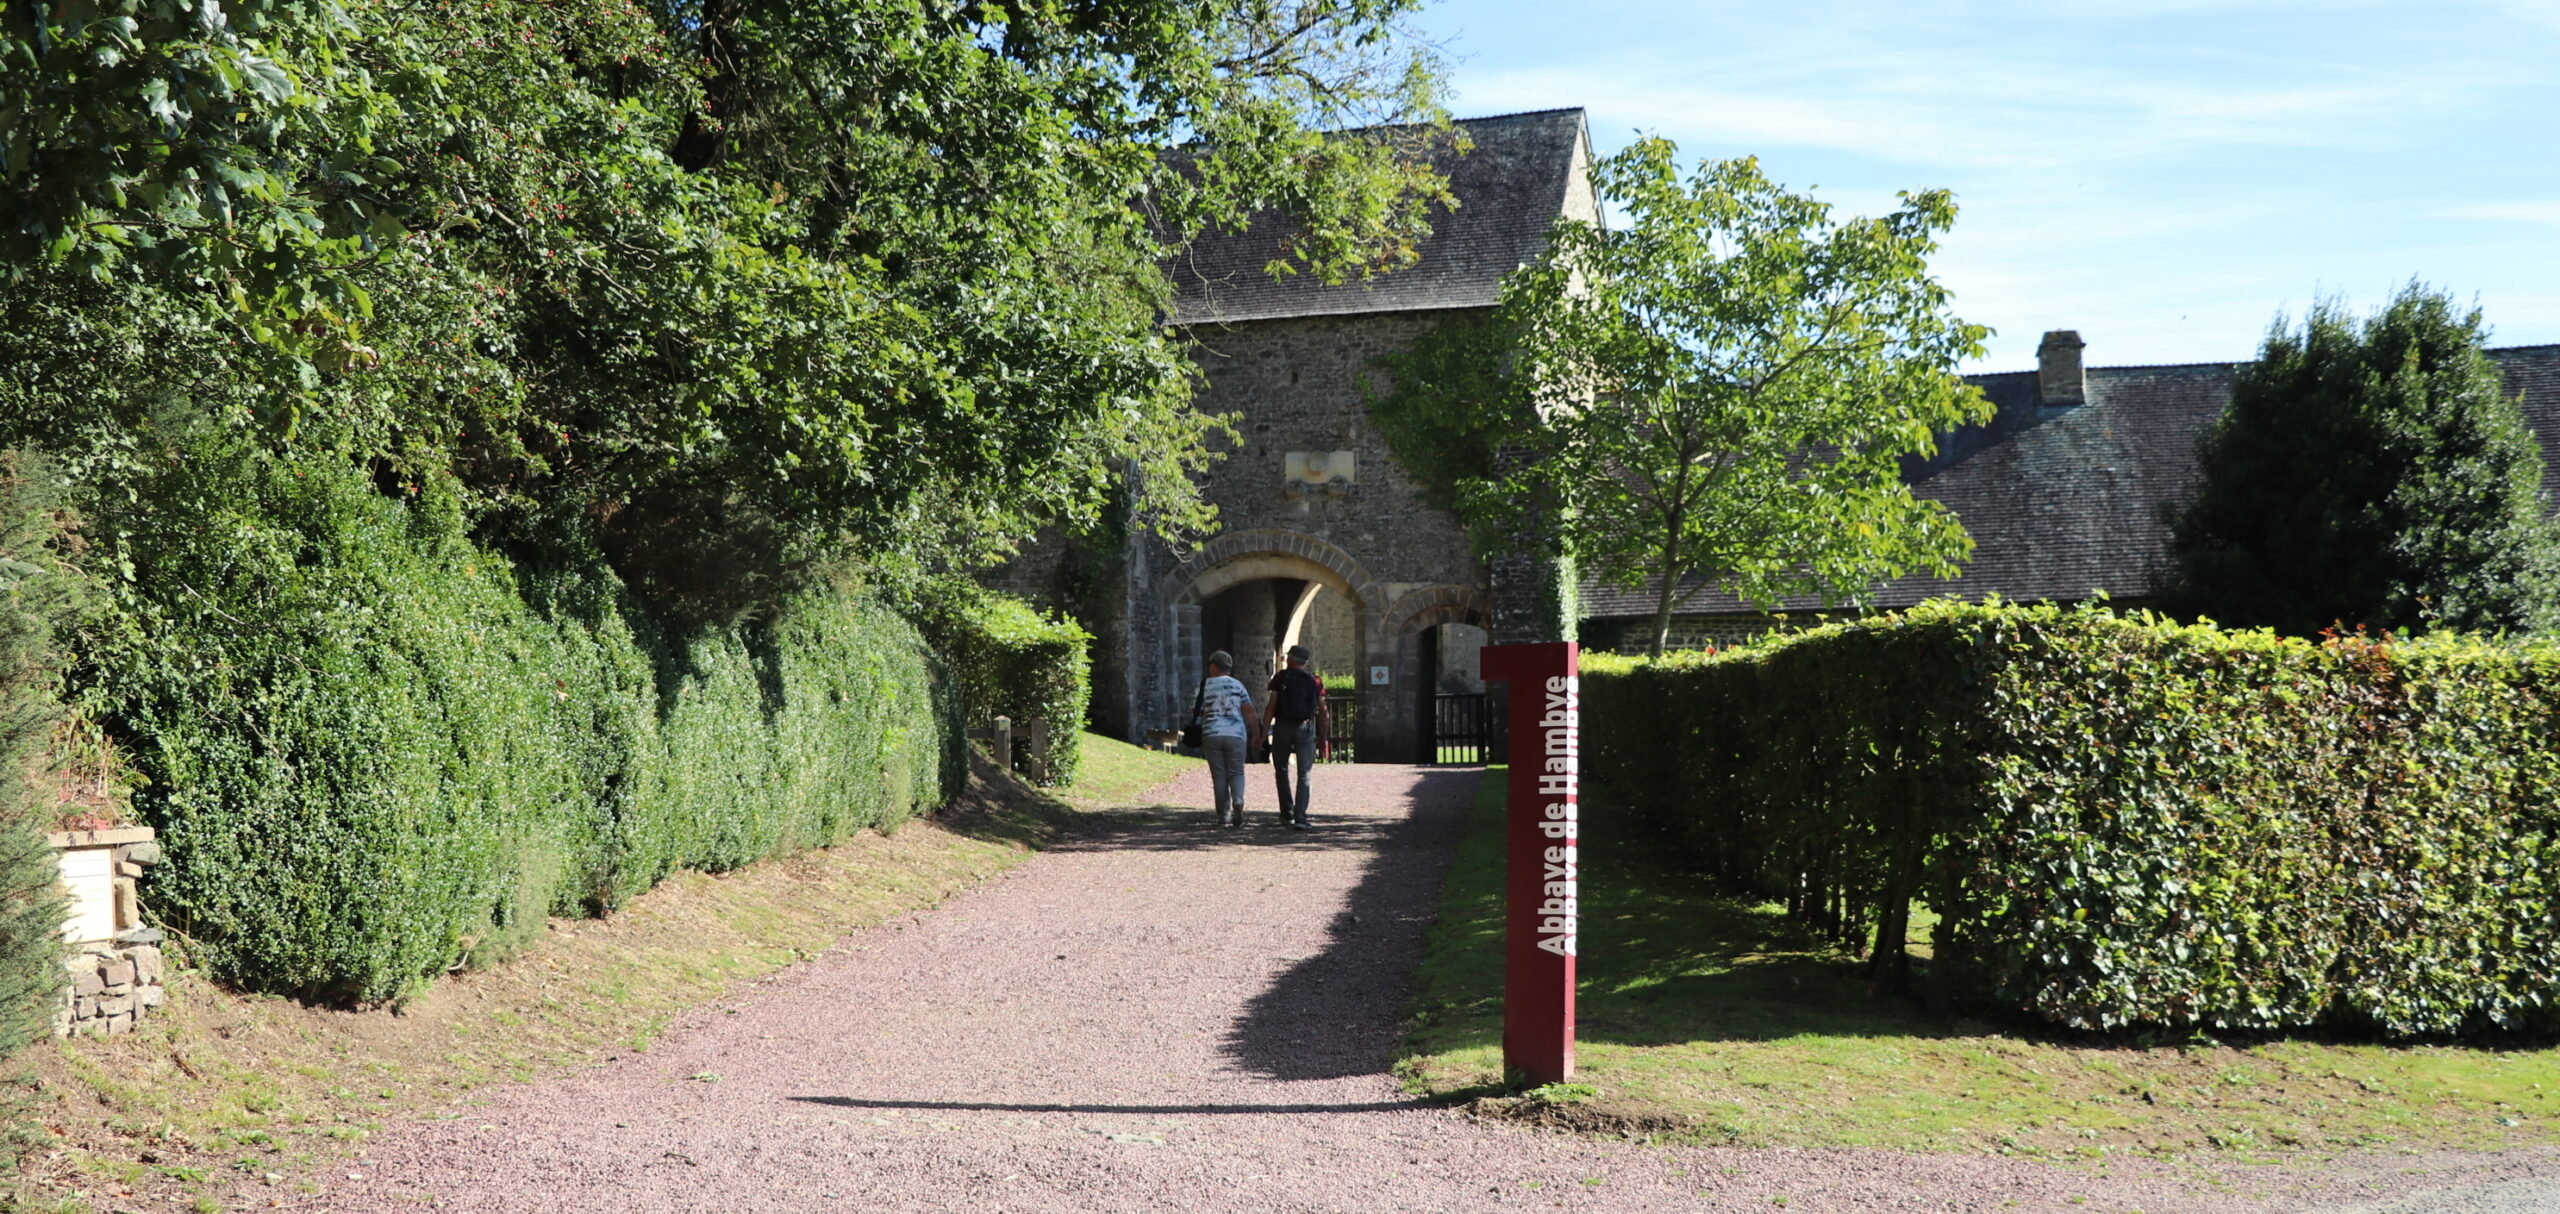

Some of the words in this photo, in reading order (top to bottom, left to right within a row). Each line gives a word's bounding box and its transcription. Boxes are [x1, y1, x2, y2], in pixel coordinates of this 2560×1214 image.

[1539, 676, 1567, 794] Hambye
[1538, 803, 1566, 838] de
[1537, 846, 1565, 956] Abbaye
